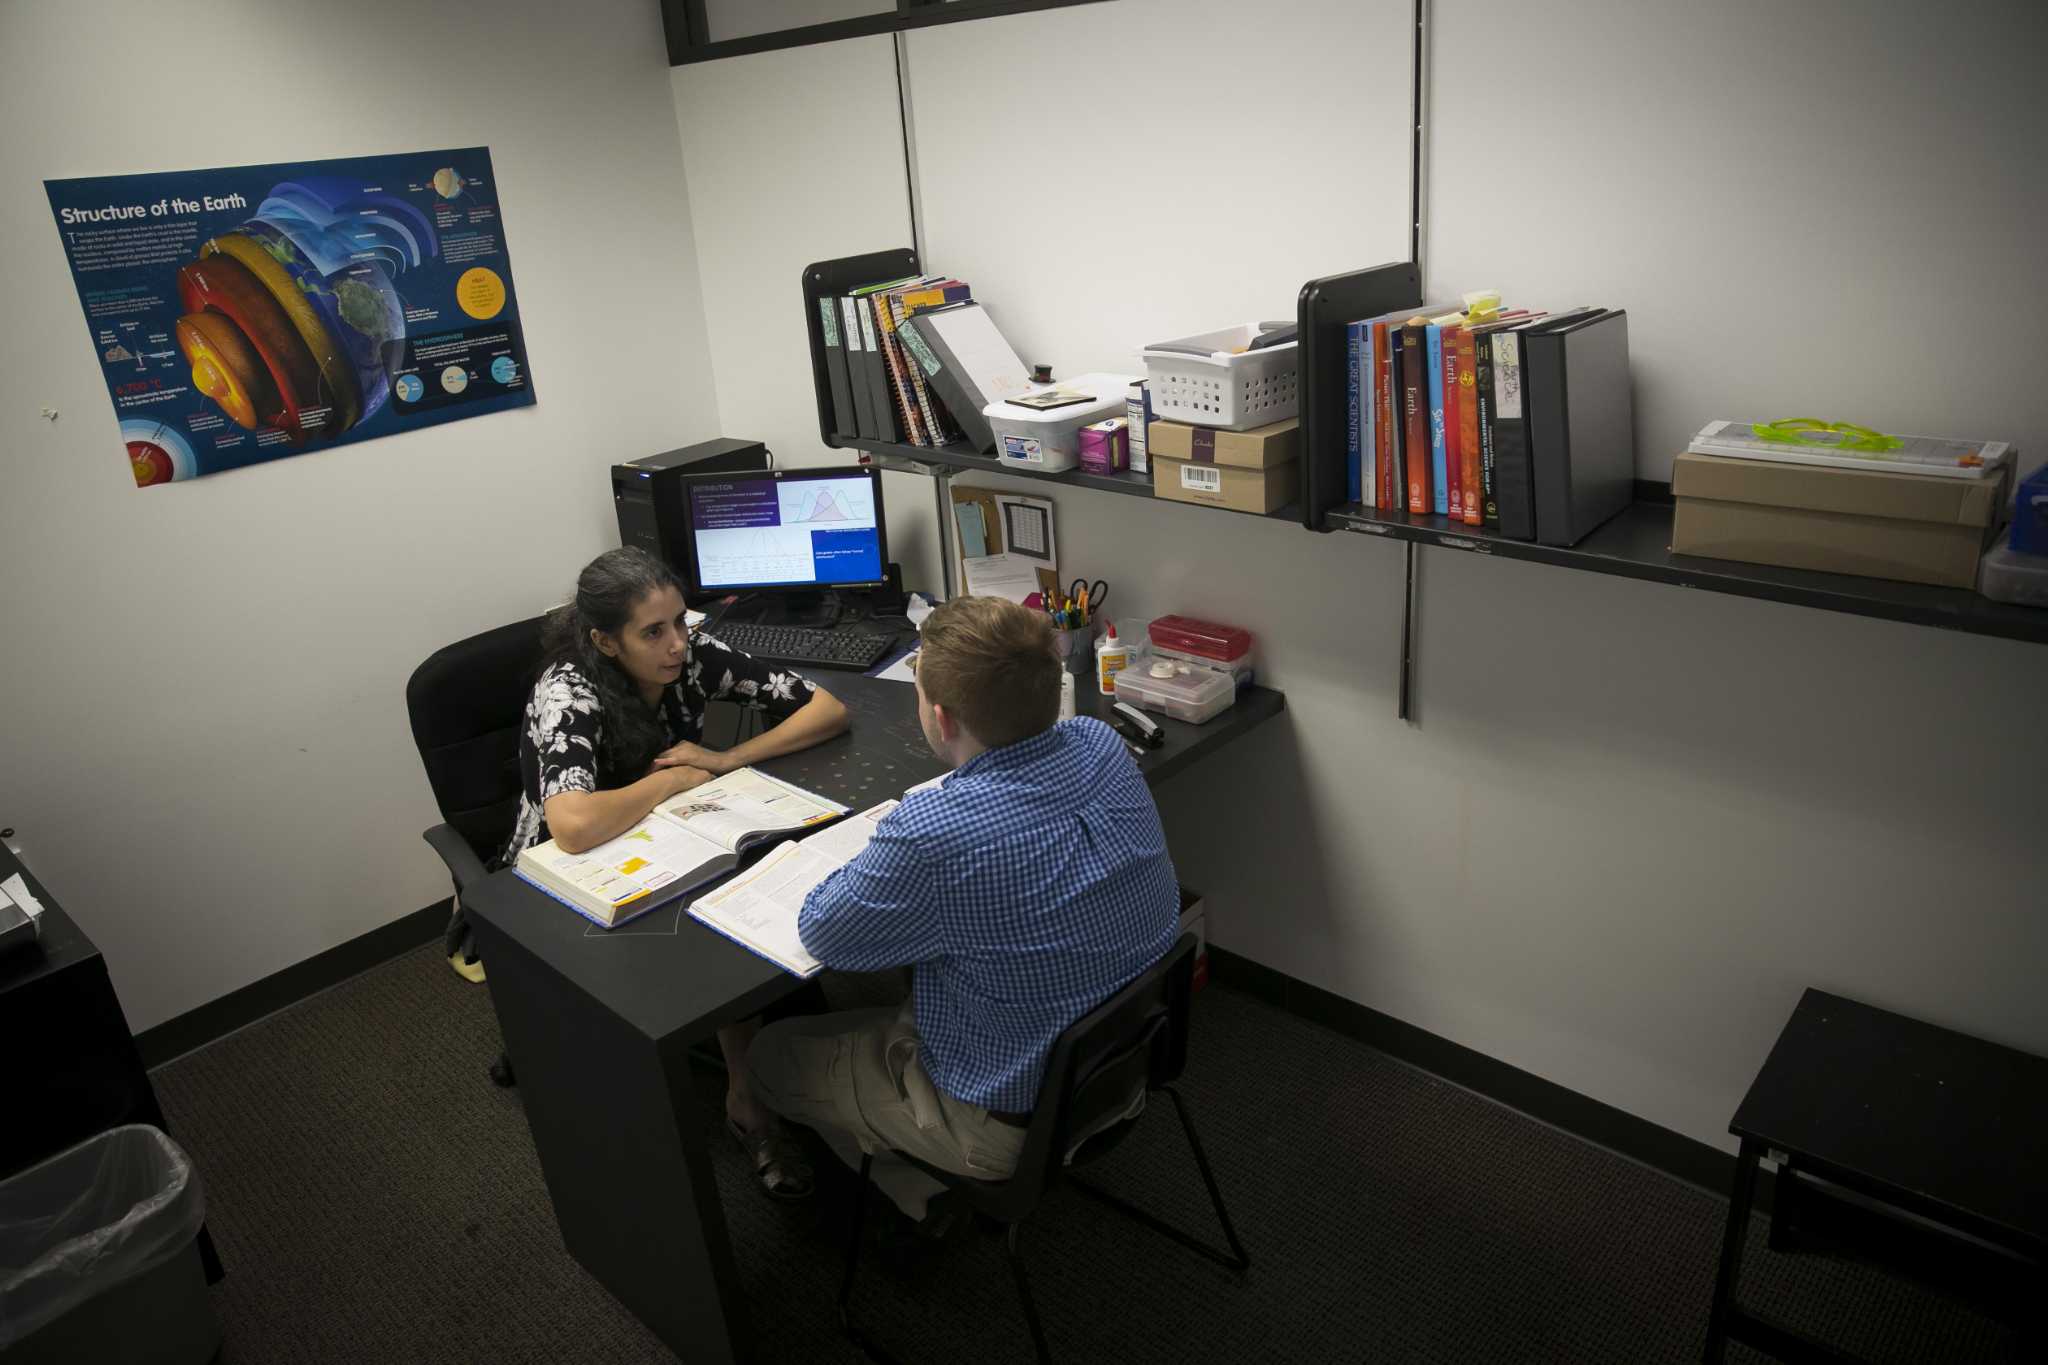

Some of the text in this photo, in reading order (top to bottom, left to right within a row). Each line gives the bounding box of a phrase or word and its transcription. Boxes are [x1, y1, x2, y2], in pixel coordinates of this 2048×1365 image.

[61, 192, 247, 224] Structure of the Earth
[1446, 354, 1457, 384] Earth
[1348, 337, 1360, 452] THE GREAT SCIENTISTS
[1407, 387, 1417, 415] Earth
